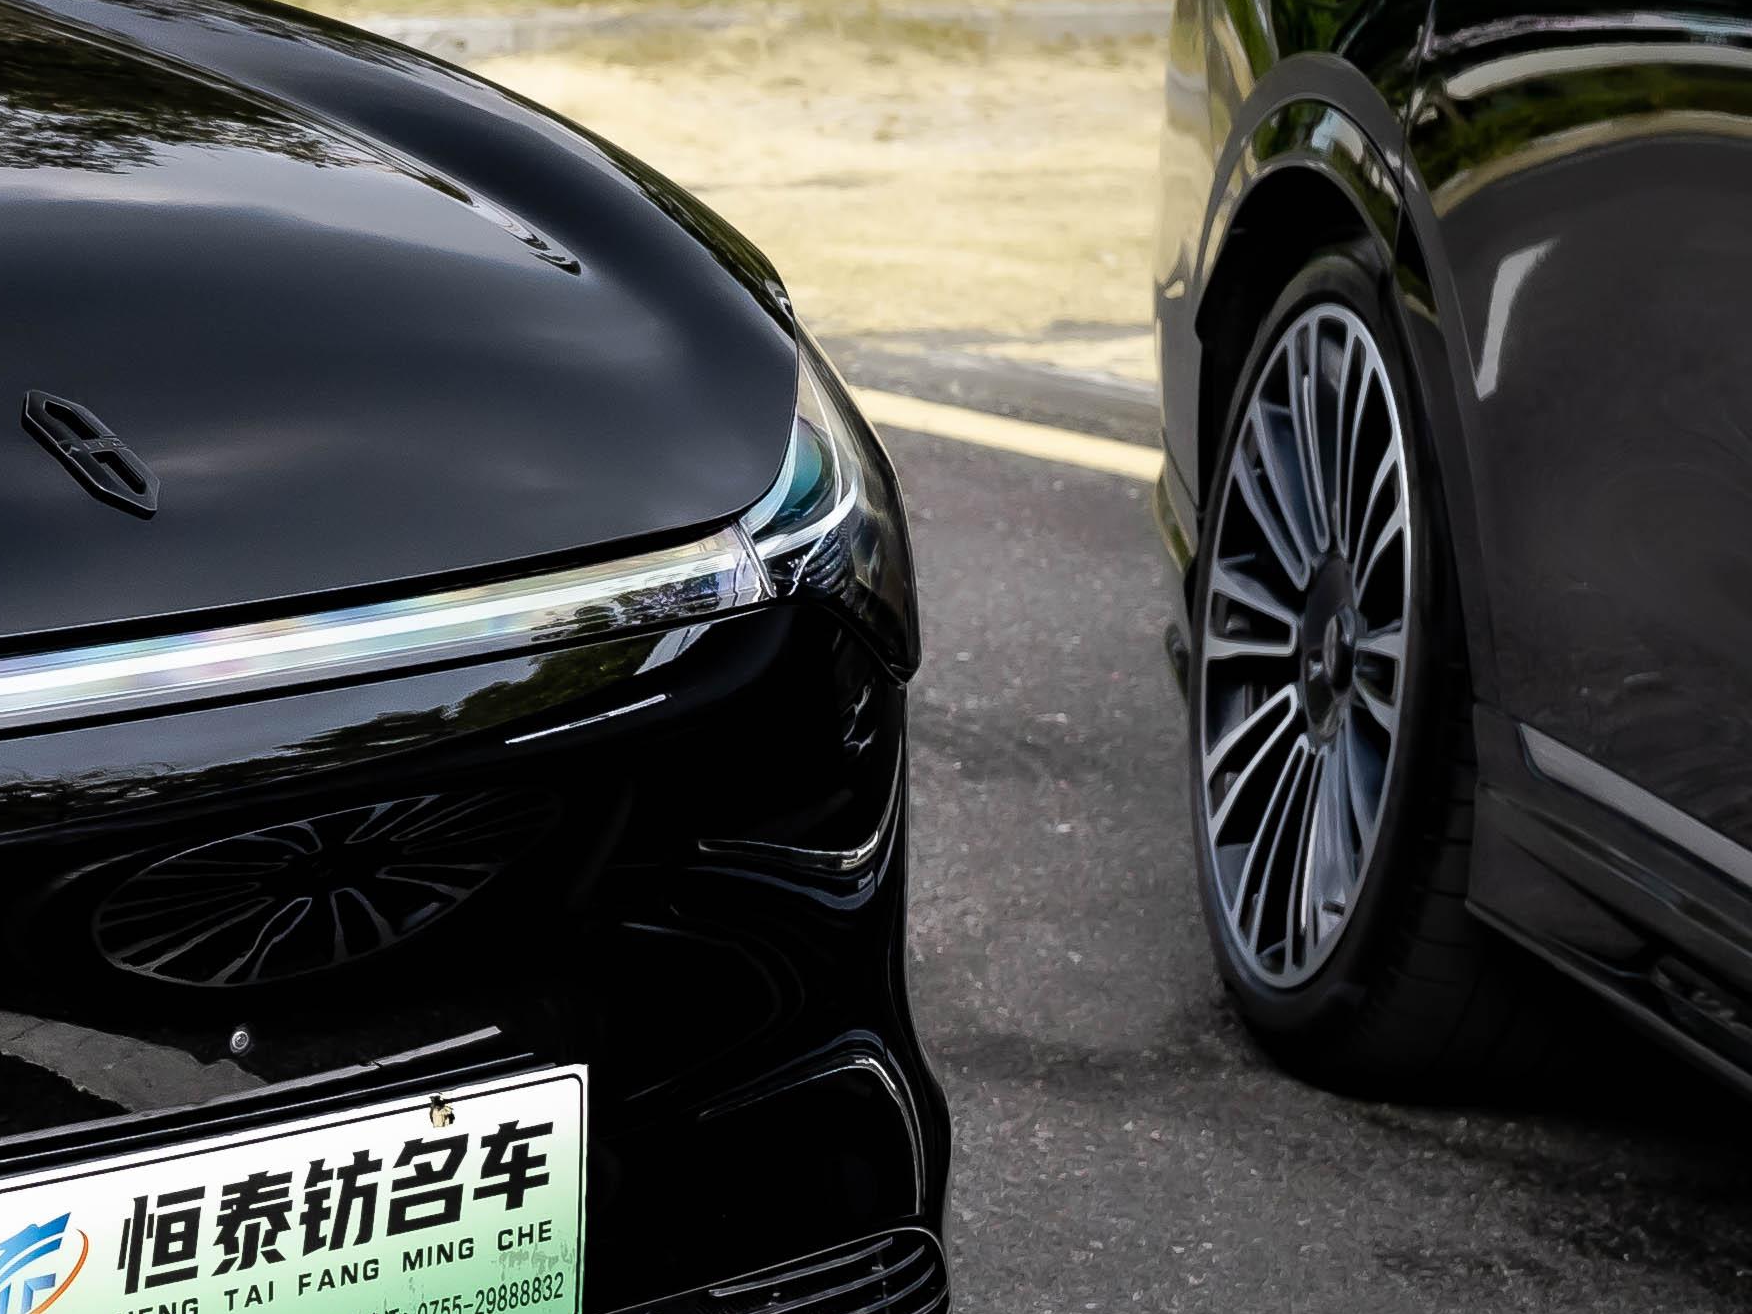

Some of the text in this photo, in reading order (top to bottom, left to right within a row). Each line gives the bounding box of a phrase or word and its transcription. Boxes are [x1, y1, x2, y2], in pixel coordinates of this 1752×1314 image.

[116, 1119, 554, 1294] 恒泰钫名车
[224, 1281, 274, 1311] TAI
[299, 1259, 379, 1296] FANG
[403, 1238, 474, 1273] MING
[498, 1220, 553, 1252] CHE
